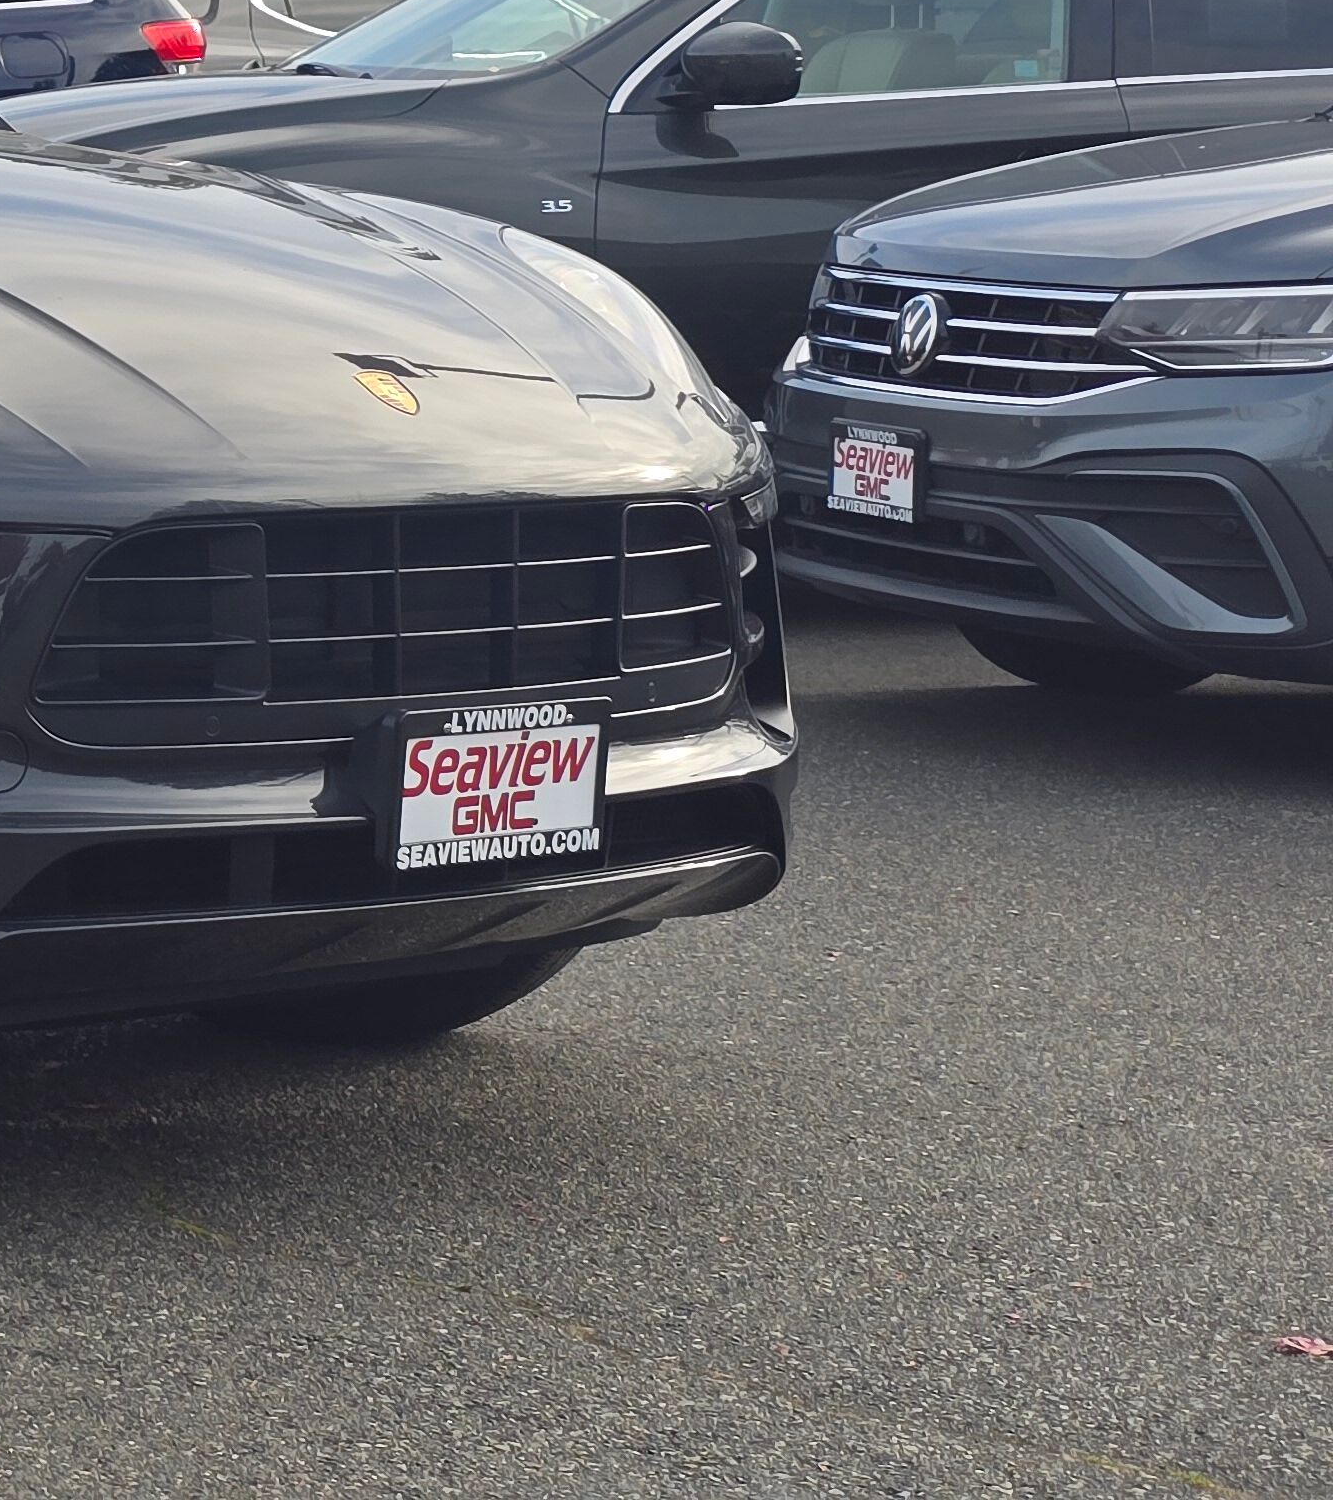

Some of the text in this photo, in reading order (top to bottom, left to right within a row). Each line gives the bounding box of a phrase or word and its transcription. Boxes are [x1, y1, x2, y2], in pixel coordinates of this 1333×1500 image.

[847, 426, 898, 445] LYNNWOOD
[834, 439, 914, 480] Seaview
[854, 474, 891, 502] GMC
[827, 495, 913, 524] SEAVIEWAUTO.COM
[450, 704, 567, 734] LYNNWOOD
[402, 731, 595, 798] Seaview
[452, 790, 537, 836] GMC
[396, 827, 600, 870] SEAVIEWAUTO.COM
